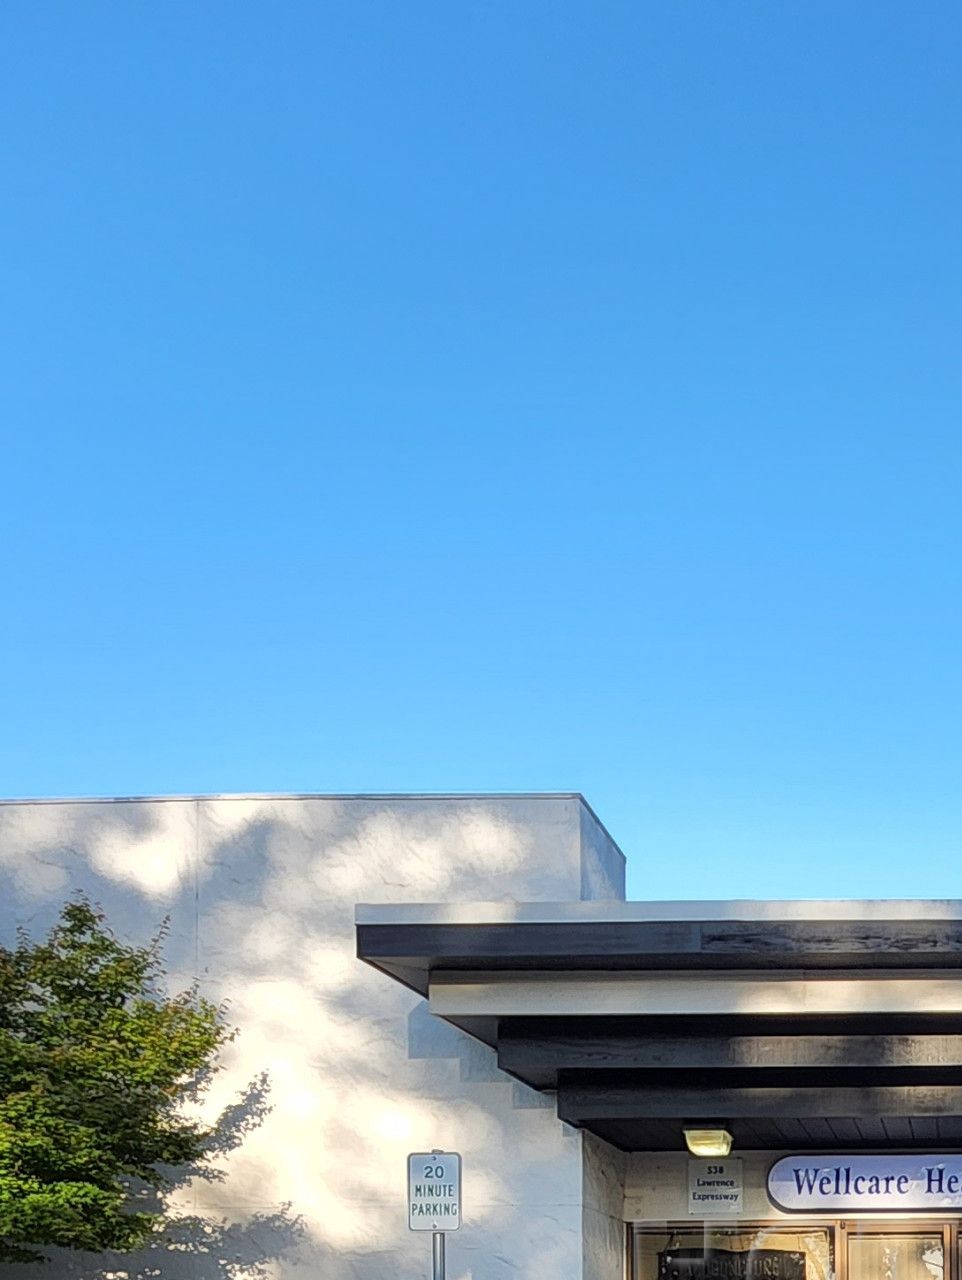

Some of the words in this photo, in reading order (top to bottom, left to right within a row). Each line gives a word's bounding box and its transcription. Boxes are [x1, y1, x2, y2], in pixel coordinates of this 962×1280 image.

[423, 1165, 444, 1179] 20
[707, 1165, 724, 1174] 538
[696, 1178, 735, 1187] Lawrence
[792, 1167, 909, 1196] Wellcare
[415, 1184, 454, 1197] MINUTE
[692, 1192, 739, 1202] Expressway
[411, 1203, 457, 1216] PARKING
[684, 1257, 780, 1277] APUNCURE
